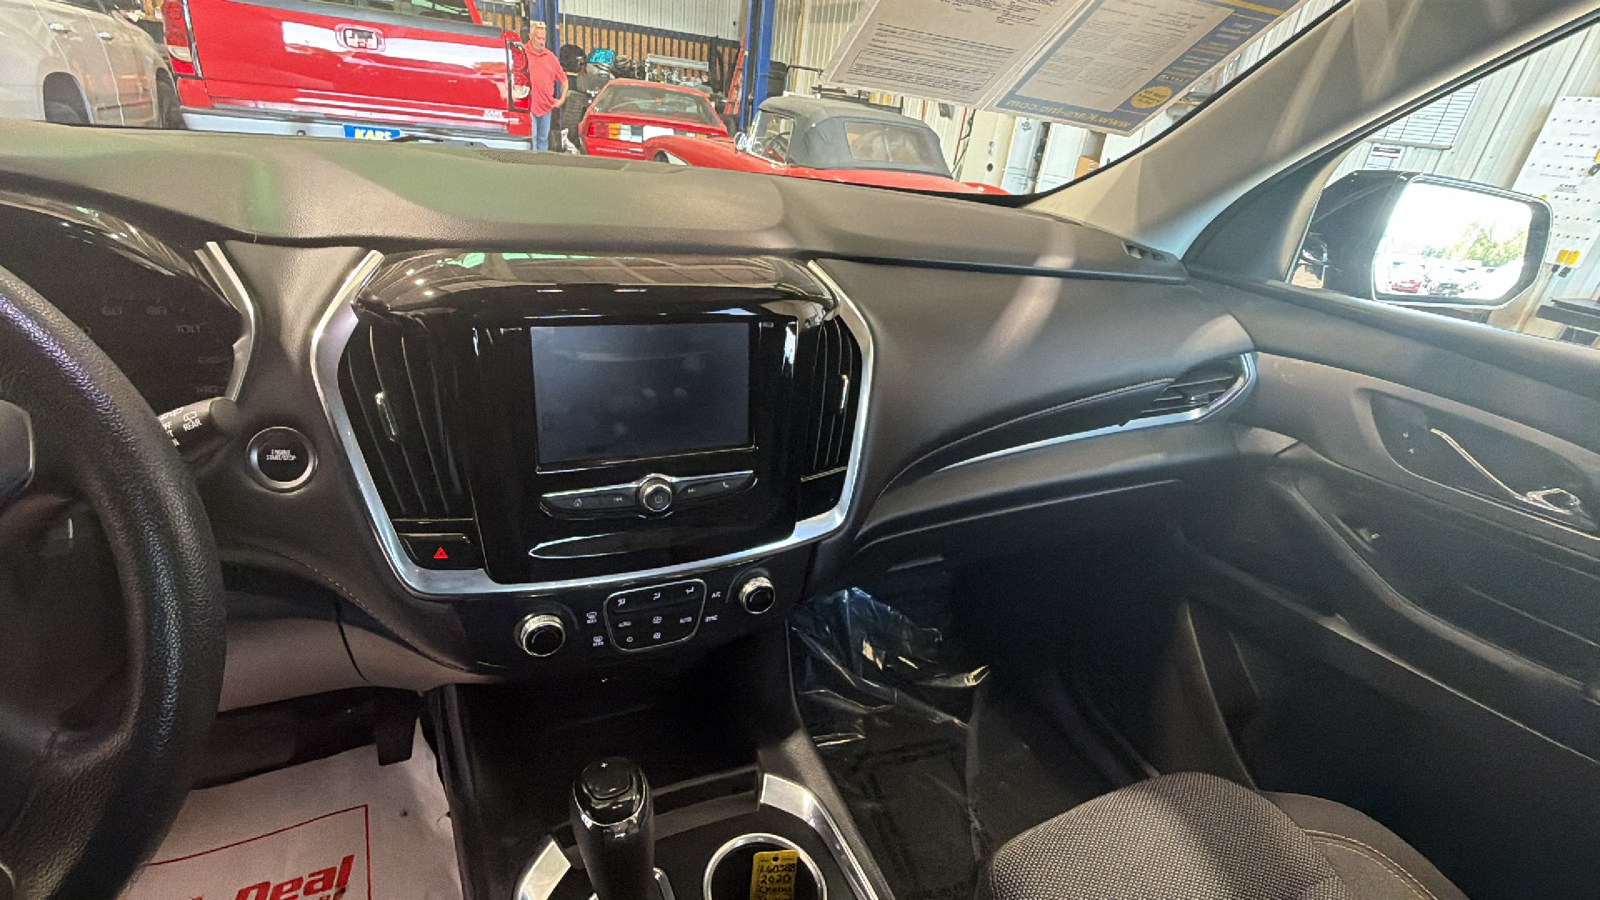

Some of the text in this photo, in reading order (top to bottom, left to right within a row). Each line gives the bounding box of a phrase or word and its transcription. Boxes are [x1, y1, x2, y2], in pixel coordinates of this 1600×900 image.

[355, 128, 392, 141] KARS
[183, 418, 203, 432] REAR
[711, 591, 721, 599] A/C
[761, 874, 792, 884] 2020
